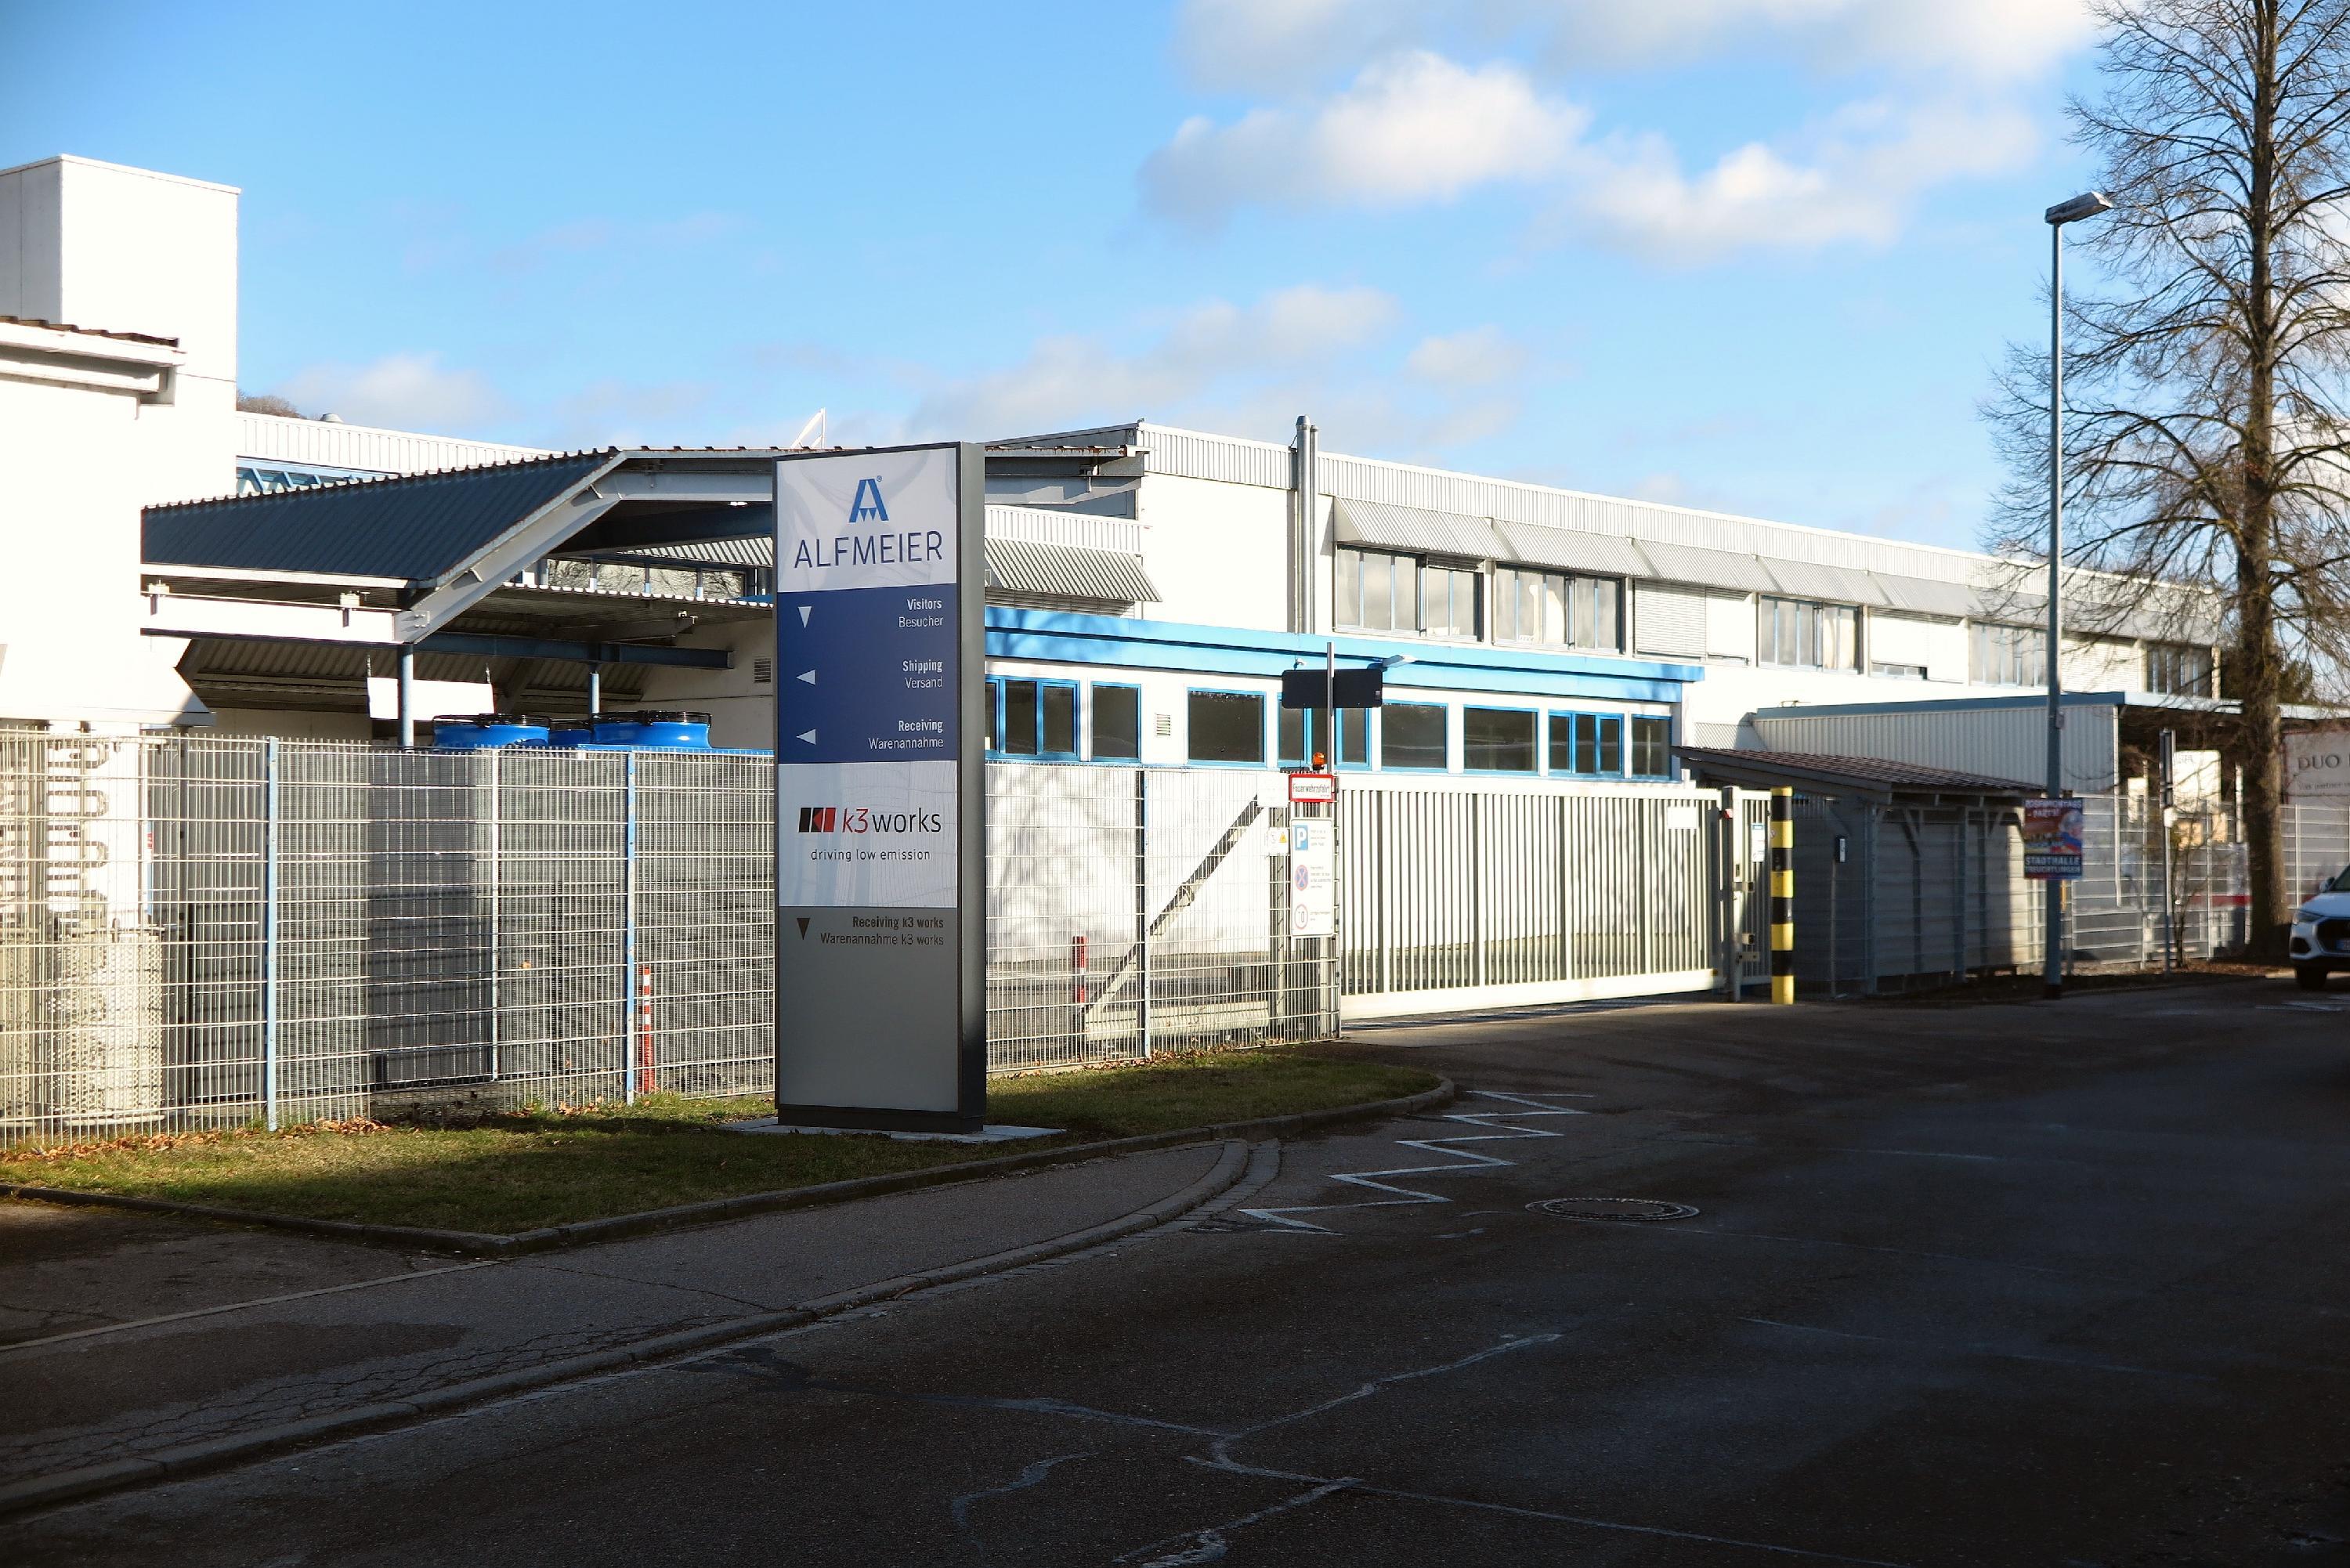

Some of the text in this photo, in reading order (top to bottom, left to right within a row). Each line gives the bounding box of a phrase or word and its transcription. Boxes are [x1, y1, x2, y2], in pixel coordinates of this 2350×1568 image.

[794, 530, 942, 569] ALFMEIER
[907, 598, 942, 611] Visitors
[898, 616, 943, 628] Besucher
[902, 659, 943, 674] Shipping
[905, 676, 943, 688] Versand
[898, 719, 943, 733] Receiving
[868, 736, 944, 750] Warenannahme
[811, 849, 931, 862] driving low emission
[852, 916, 944, 930] Receiving k3 works
[820, 932, 944, 945] Warenannahme k3 works
